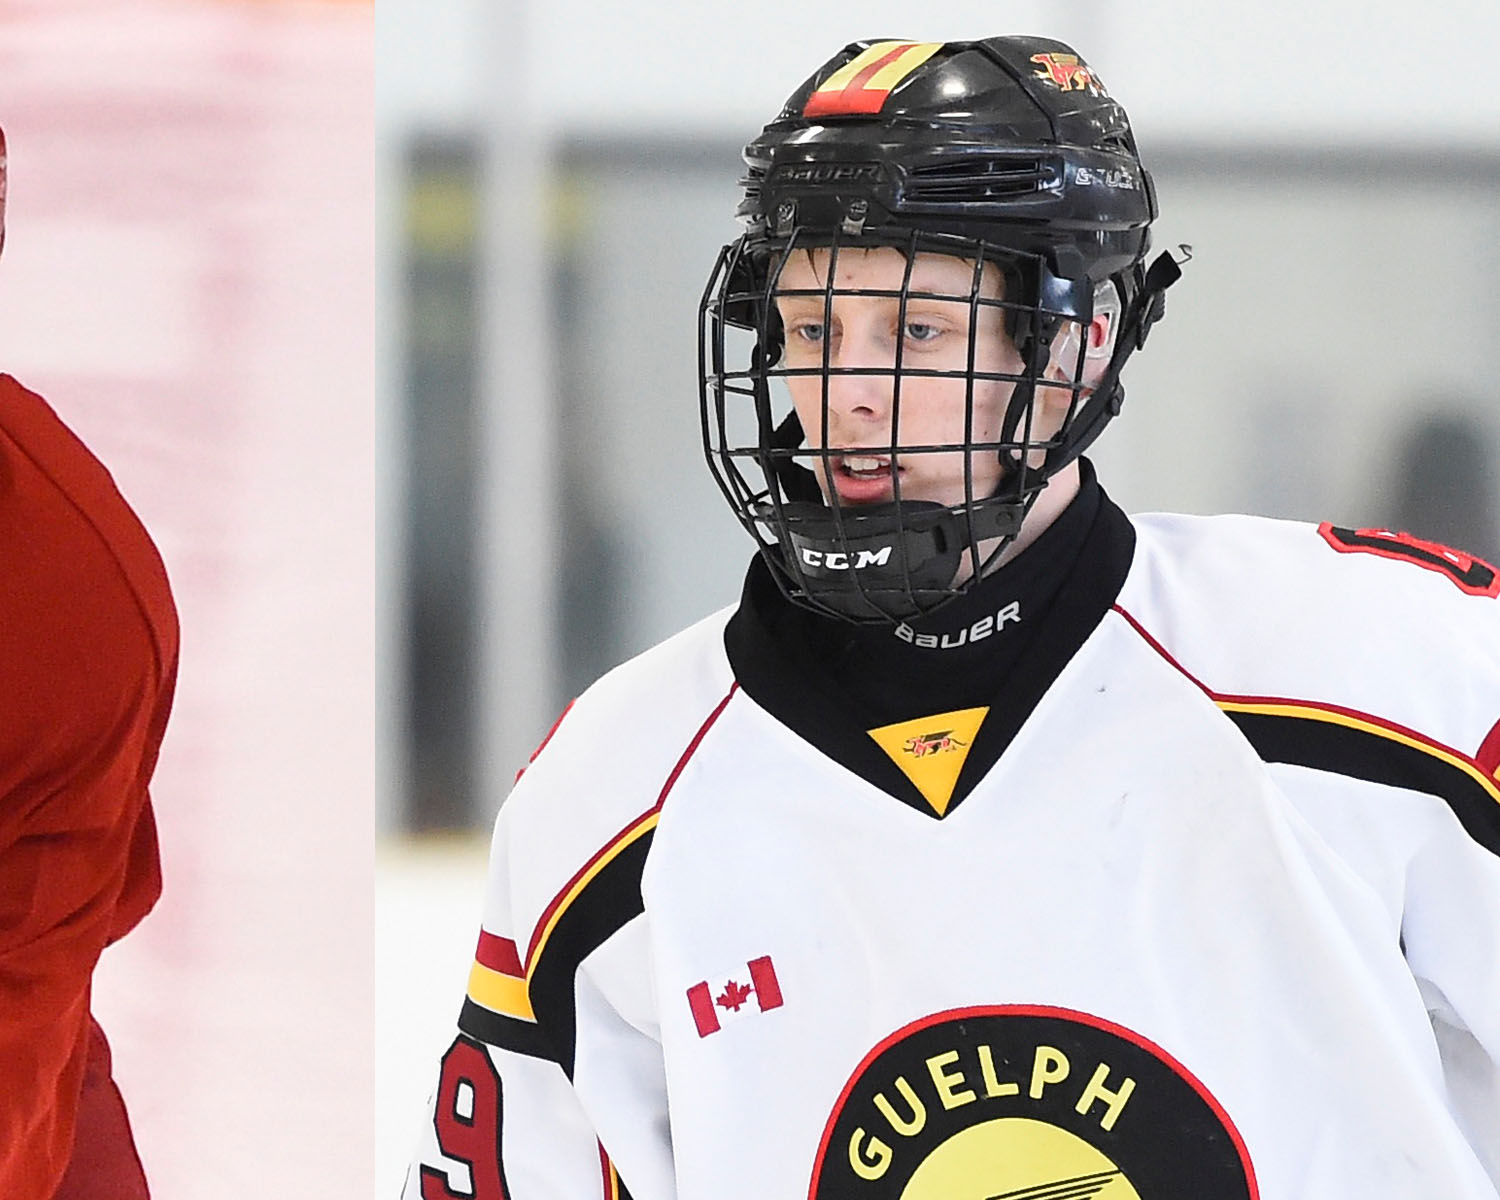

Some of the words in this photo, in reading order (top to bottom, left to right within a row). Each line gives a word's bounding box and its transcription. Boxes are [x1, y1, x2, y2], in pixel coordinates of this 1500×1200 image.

[801, 545, 894, 571] CCM
[893, 599, 1022, 650] BAUER
[848, 1045, 1136, 1181] GUELPH
